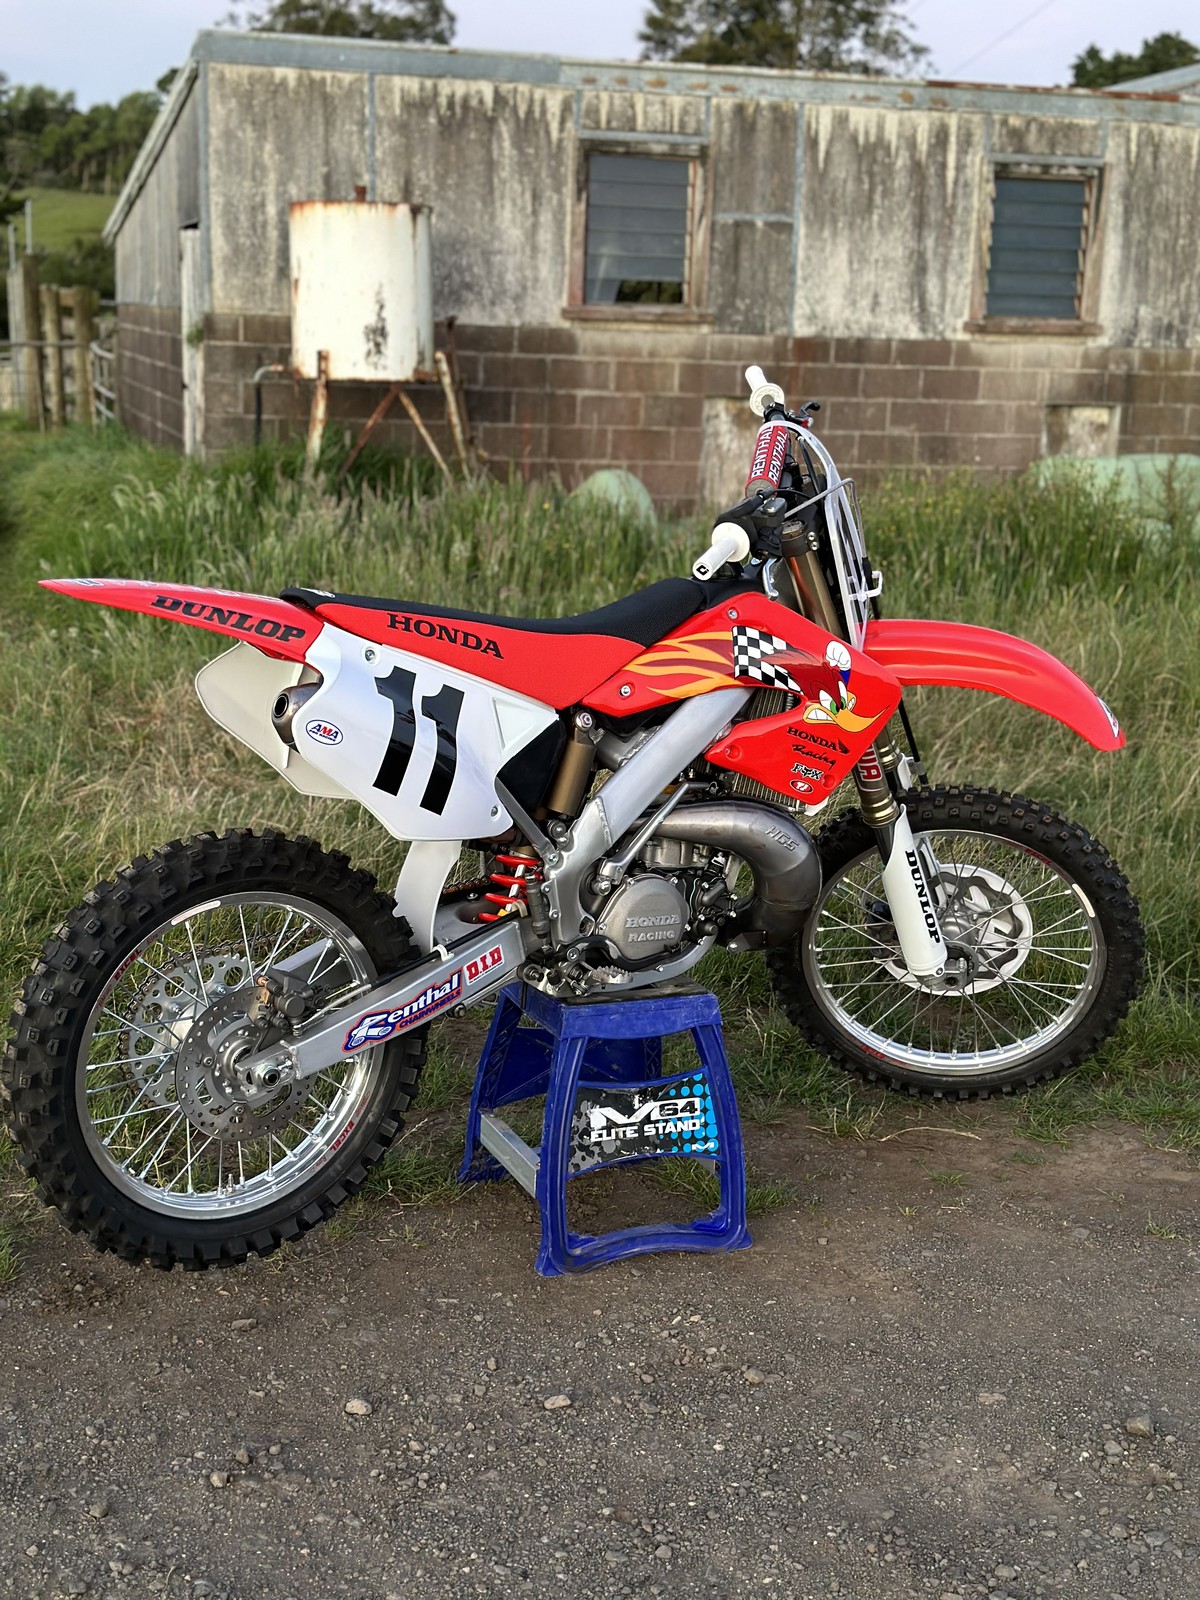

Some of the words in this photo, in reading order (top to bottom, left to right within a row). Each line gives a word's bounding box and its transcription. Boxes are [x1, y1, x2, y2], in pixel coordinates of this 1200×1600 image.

[751, 425, 774, 478] RENTHAL
[767, 430, 788, 485] RENTHAL
[150, 595, 306, 643] DUNLOP
[386, 612, 505, 660] HONDA
[310, 723, 340, 739] AMA
[372, 665, 466, 817] 11
[786, 726, 838, 752] HONDA
[791, 743, 837, 771] Racing
[764, 824, 800, 852] HGS
[905, 849, 941, 944] DUNLOP
[625, 914, 681, 928] HONDA
[628, 930, 676, 942] RACING
[347, 972, 460, 1048] Renthal
[399, 988, 461, 1028] CHAINWHEELS
[590, 1125, 639, 1143] ELITE
[643, 1118, 701, 1137] STAND
